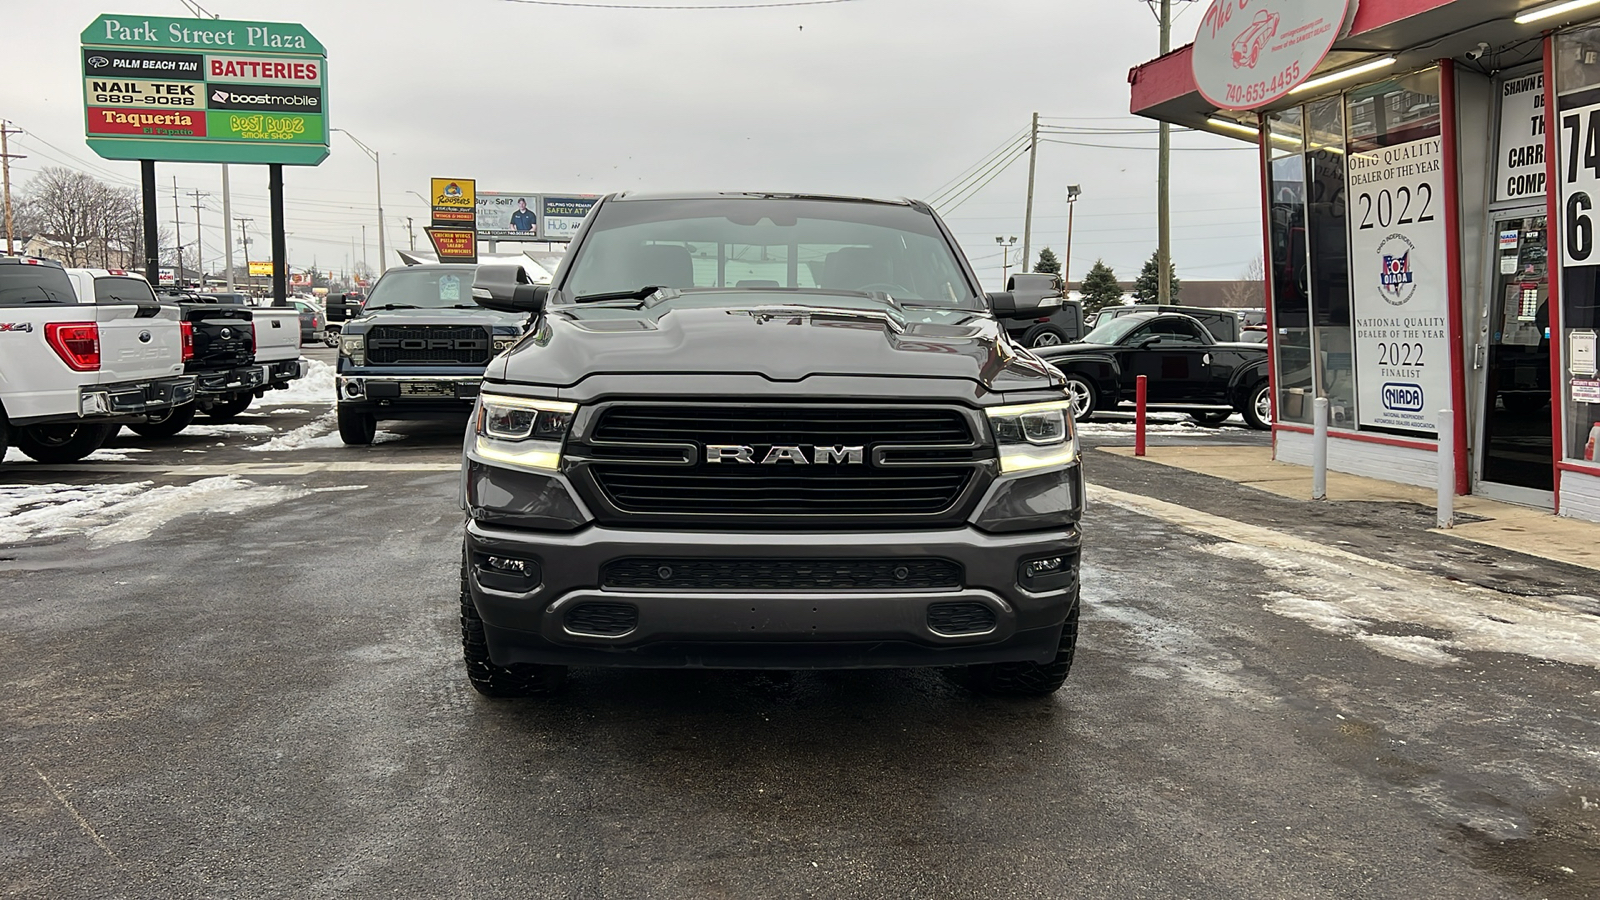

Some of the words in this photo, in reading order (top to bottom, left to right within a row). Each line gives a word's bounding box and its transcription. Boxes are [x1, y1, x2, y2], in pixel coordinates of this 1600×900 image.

[103, 19, 159, 42] Park
[169, 22, 236, 44] Street
[246, 26, 306, 49] Plaza
[113, 59, 140, 69] PALM
[142, 60, 175, 71] BEACH
[178, 61, 198, 71] TAN
[211, 60, 318, 80] BATTERIES
[93, 81, 142, 94] NAIL
[151, 83, 195, 96] TEK
[1225, 60, 1300, 103] 740-653-4455
[1504, 77, 1536, 97] SHAWN
[1537, 74, 1545, 88] E
[95, 94, 195, 106] 689-9088
[271, 132, 294, 140] SHOP
[1349, 153, 1380, 171] OHIO
[1384, 140, 1441, 165] QUALITY
[1351, 170, 1383, 186] DEALER
[1383, 168, 1395, 180] OF
[1396, 165, 1414, 178] THE
[1415, 159, 1440, 175] YEAR
[1507, 172, 1547, 197] COMP
[437, 195, 471, 206] Roosters
[1358, 182, 1434, 230] 2022
[1567, 191, 1592, 261] 6
[1384, 273, 1408, 284] OIADA
[1356, 318, 1401, 327] NATIONAL
[1403, 317, 1445, 328] QUALITY
[1358, 330, 1387, 339] DEALER
[1390, 330, 1400, 339] OF
[1403, 330, 1419, 339] THE
[1422, 330, 1445, 339] YEAR
[369, 339, 487, 350] FORD
[1377, 342, 1425, 367] 2022
[1381, 368, 1421, 378] FINALIST
[1385, 388, 1420, 406] NIADA
[706, 444, 864, 464] RAM
